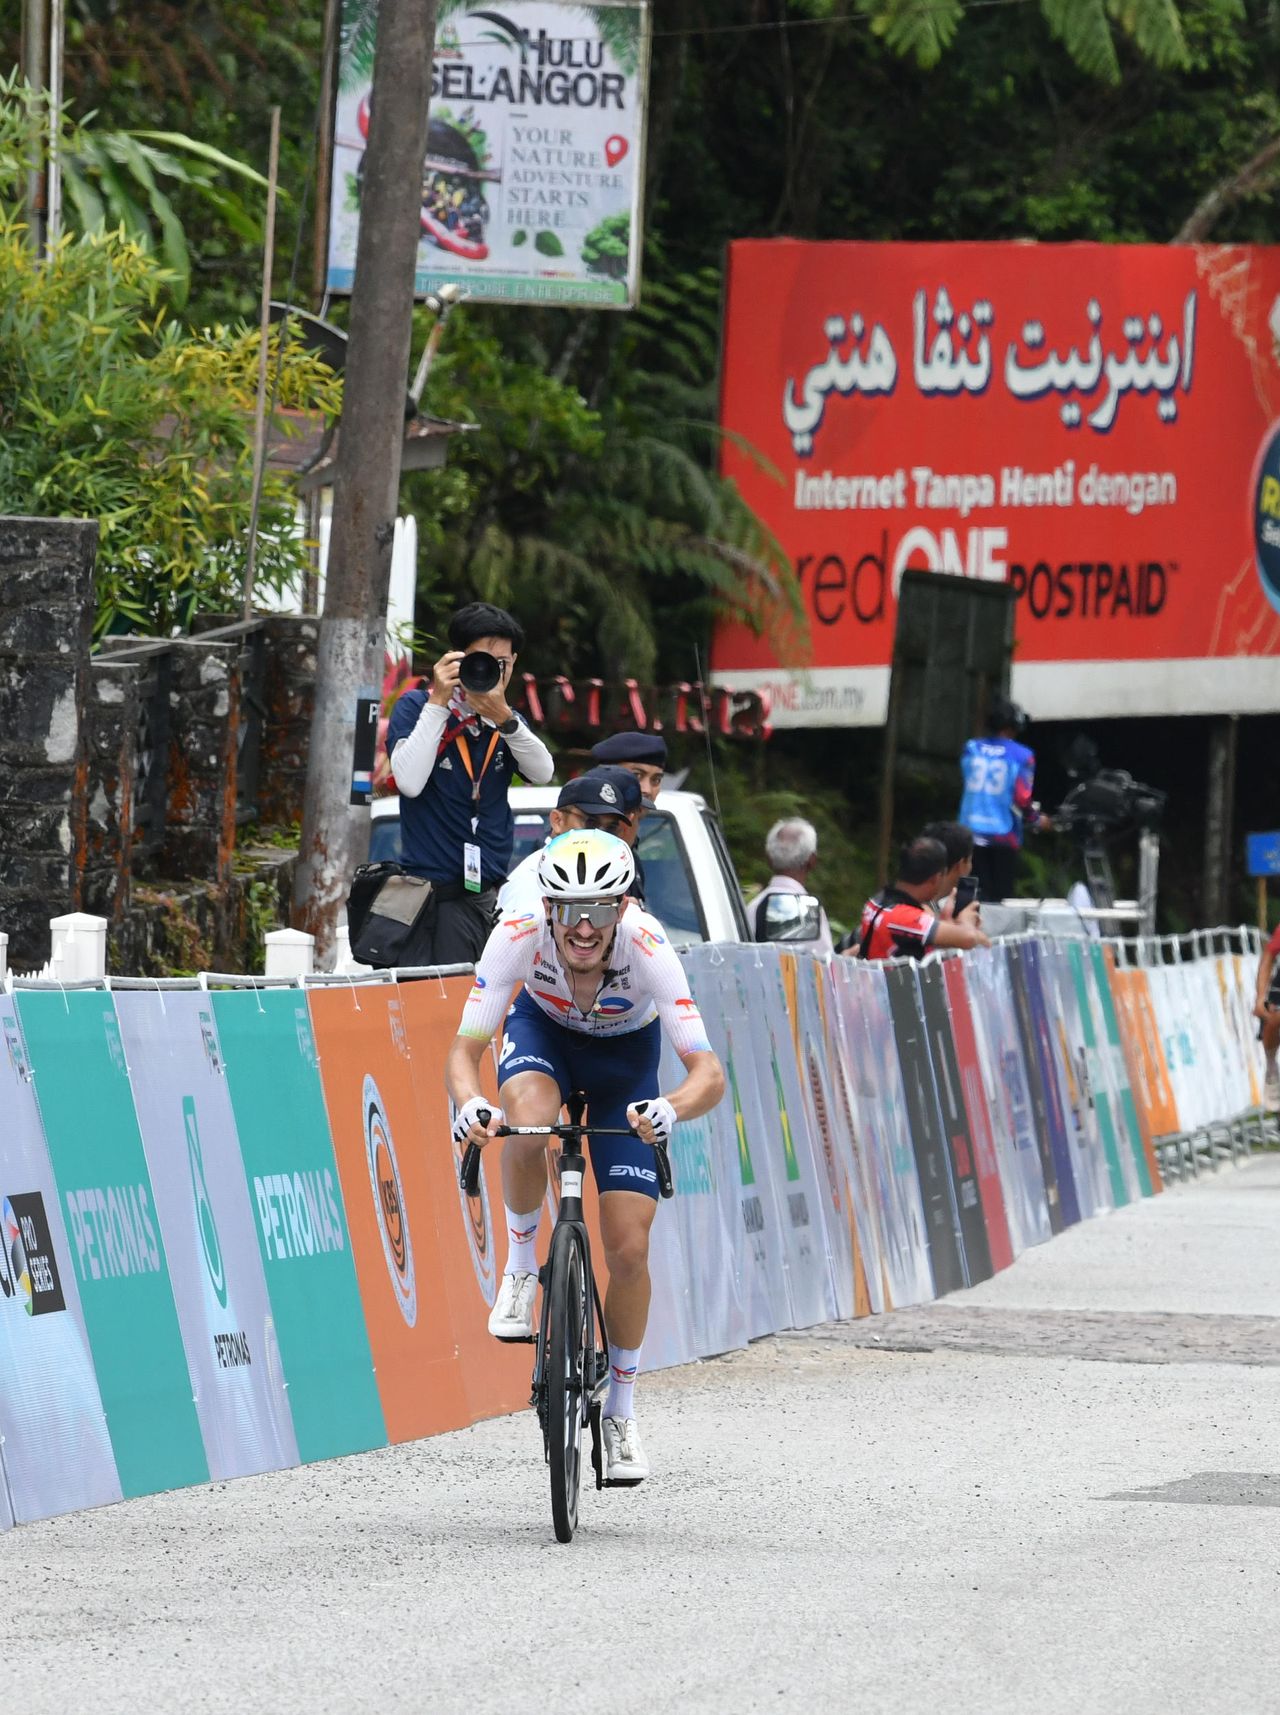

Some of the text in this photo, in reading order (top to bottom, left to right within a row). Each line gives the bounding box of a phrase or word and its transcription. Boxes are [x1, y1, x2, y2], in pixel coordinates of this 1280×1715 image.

[518, 28, 604, 68] HULU
[513, 126, 573, 145] YOUR
[510, 147, 601, 169] NATURE
[507, 187, 590, 207] STARTS
[510, 168, 624, 189] ADVENTURE
[793, 458, 1178, 518] Internet Tanpa Henti dengan
[66, 1183, 161, 1282] PETRONAS
[254, 1167, 345, 1261] PETRONAS
[20, 1215, 38, 1252] PRO
[29, 1255, 55, 1294] SERIES
[214, 1331, 252, 1368] PETRONAS
